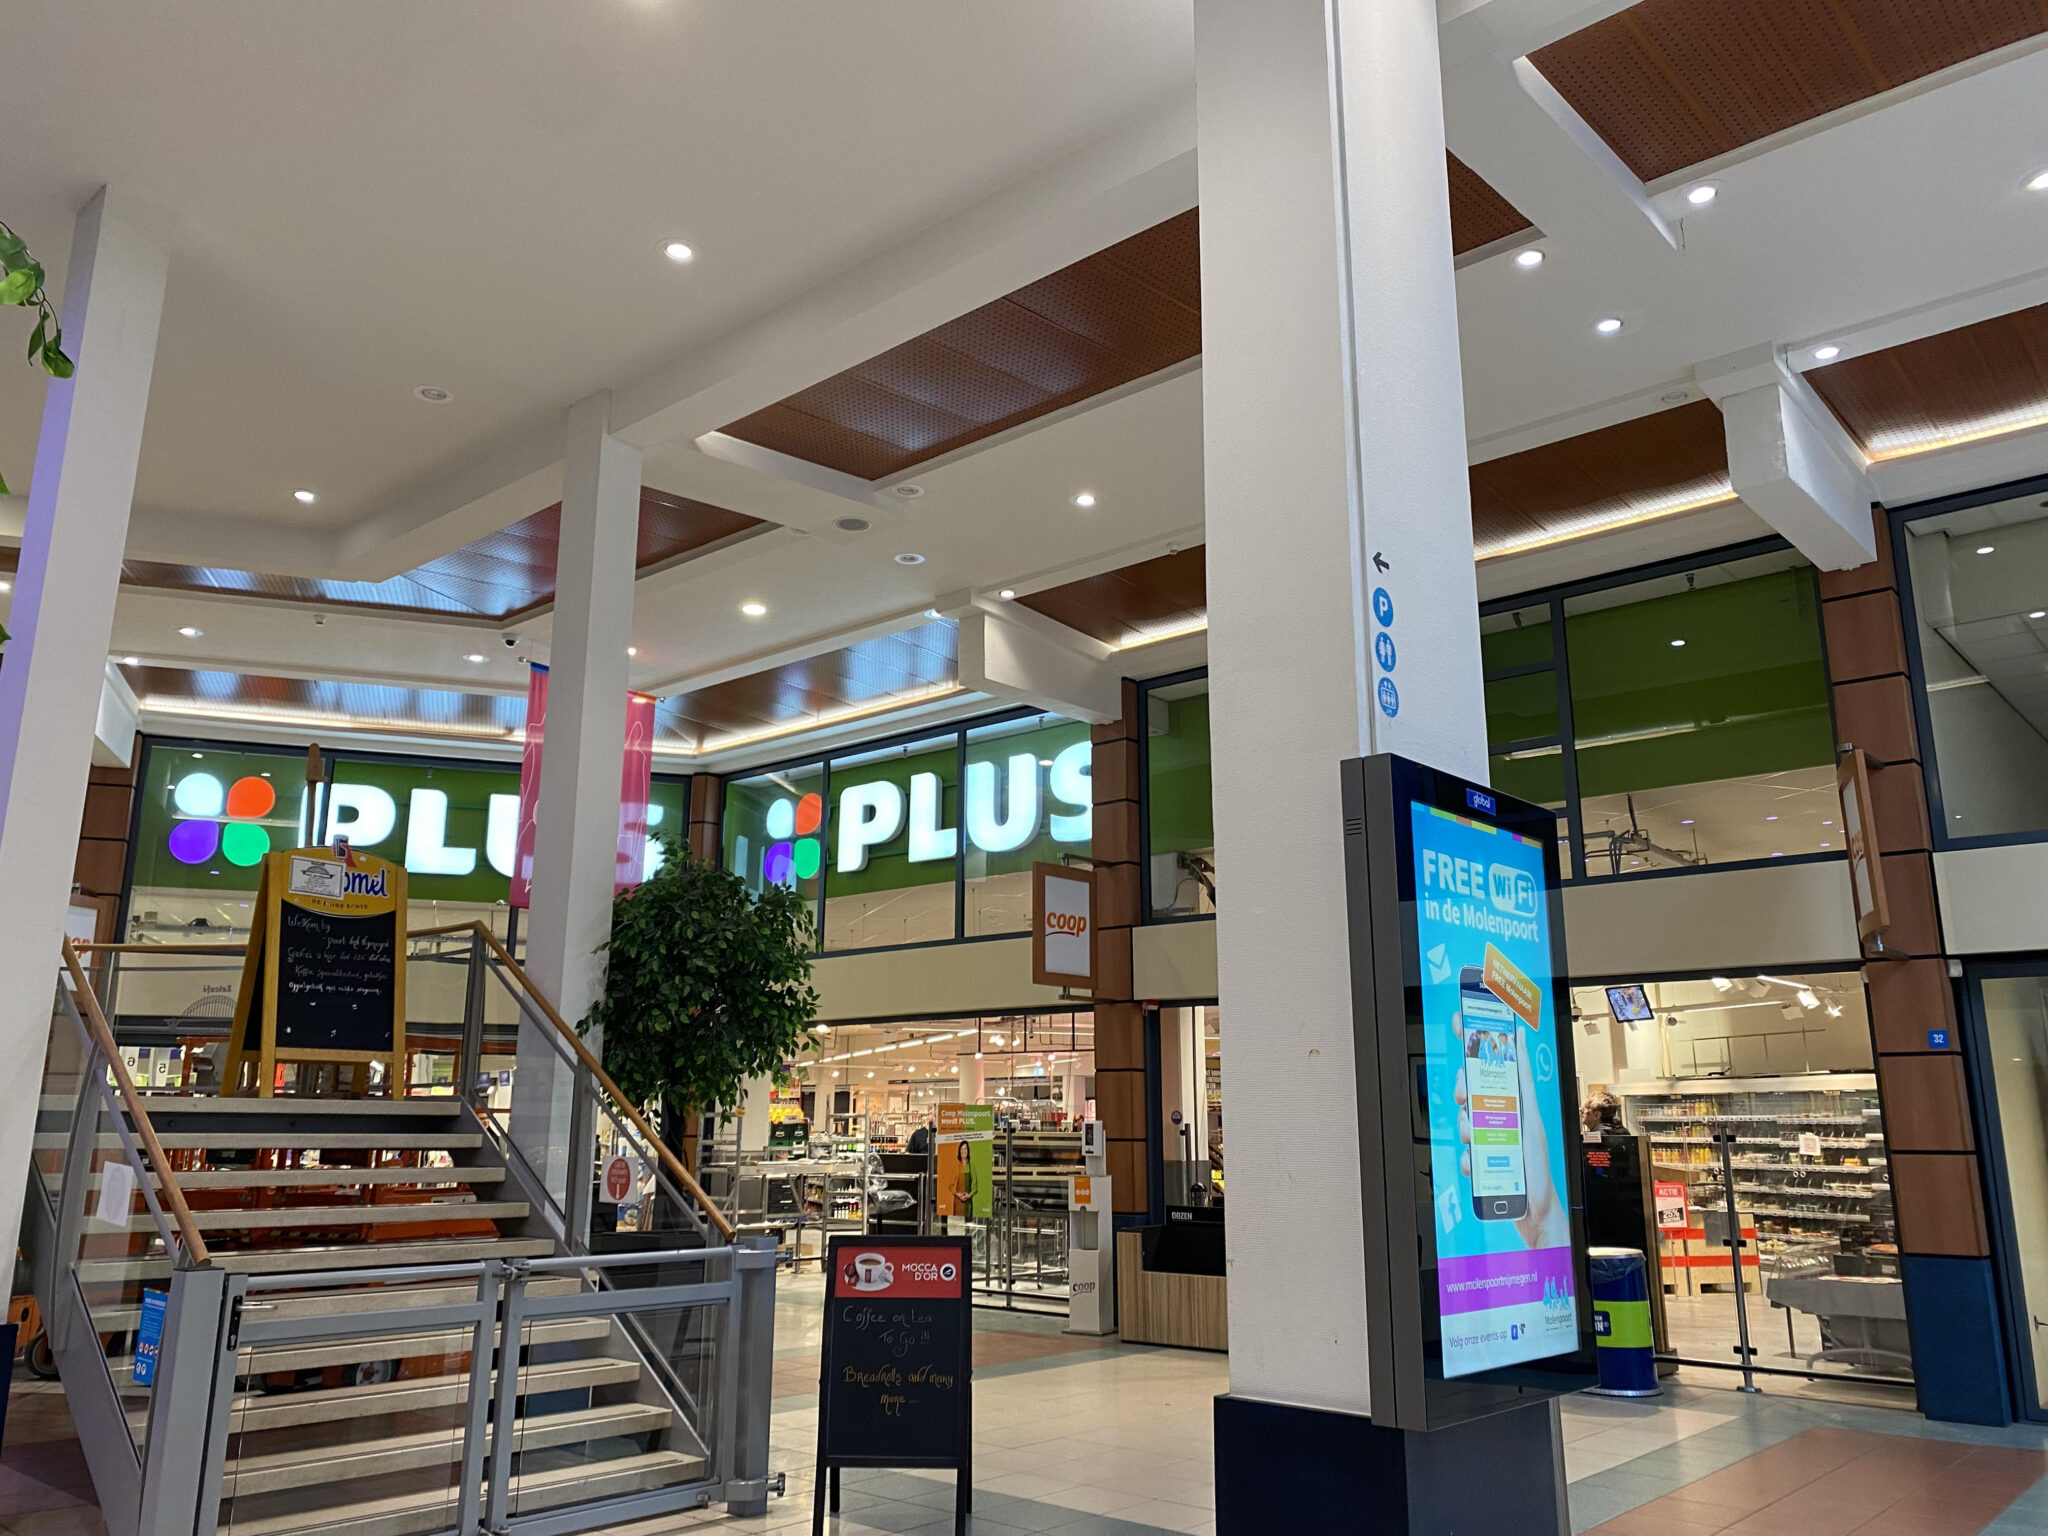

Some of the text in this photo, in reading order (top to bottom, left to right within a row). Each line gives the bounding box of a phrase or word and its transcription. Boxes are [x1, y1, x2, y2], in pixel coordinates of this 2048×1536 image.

[837, 741, 1092, 873] PLUS
[1473, 793, 1490, 809] global
[1423, 848, 1485, 899] FREE
[1046, 911, 1087, 937] coop
[1425, 892, 1539, 942] in de Molenpoort
[1492, 971, 1532, 1013] FREE Molenpoort
[1933, 1034, 1944, 1043] 32
[941, 1110, 956, 1118] Coop
[1659, 1188, 1679, 1196] ACTIE
[1663, 1208, 1680, 1218] 25%
[902, 1263, 938, 1273] MOCCA
[915, 1272, 938, 1281] D'OR
[1073, 1280, 1095, 1293] coop
[1446, 1272, 1538, 1293] www.molenpoortnijmegen.nl
[843, 1305, 886, 1330] Coffee
[911, 1308, 932, 1323] tea
[1545, 1314, 1572, 1325] Molenpoort
[879, 1329, 894, 1344] To
[893, 1331, 915, 1357] Go
[1449, 1331, 1508, 1349] Volg onze events op
[908, 1364, 933, 1382] and
[929, 1373, 953, 1389] many
